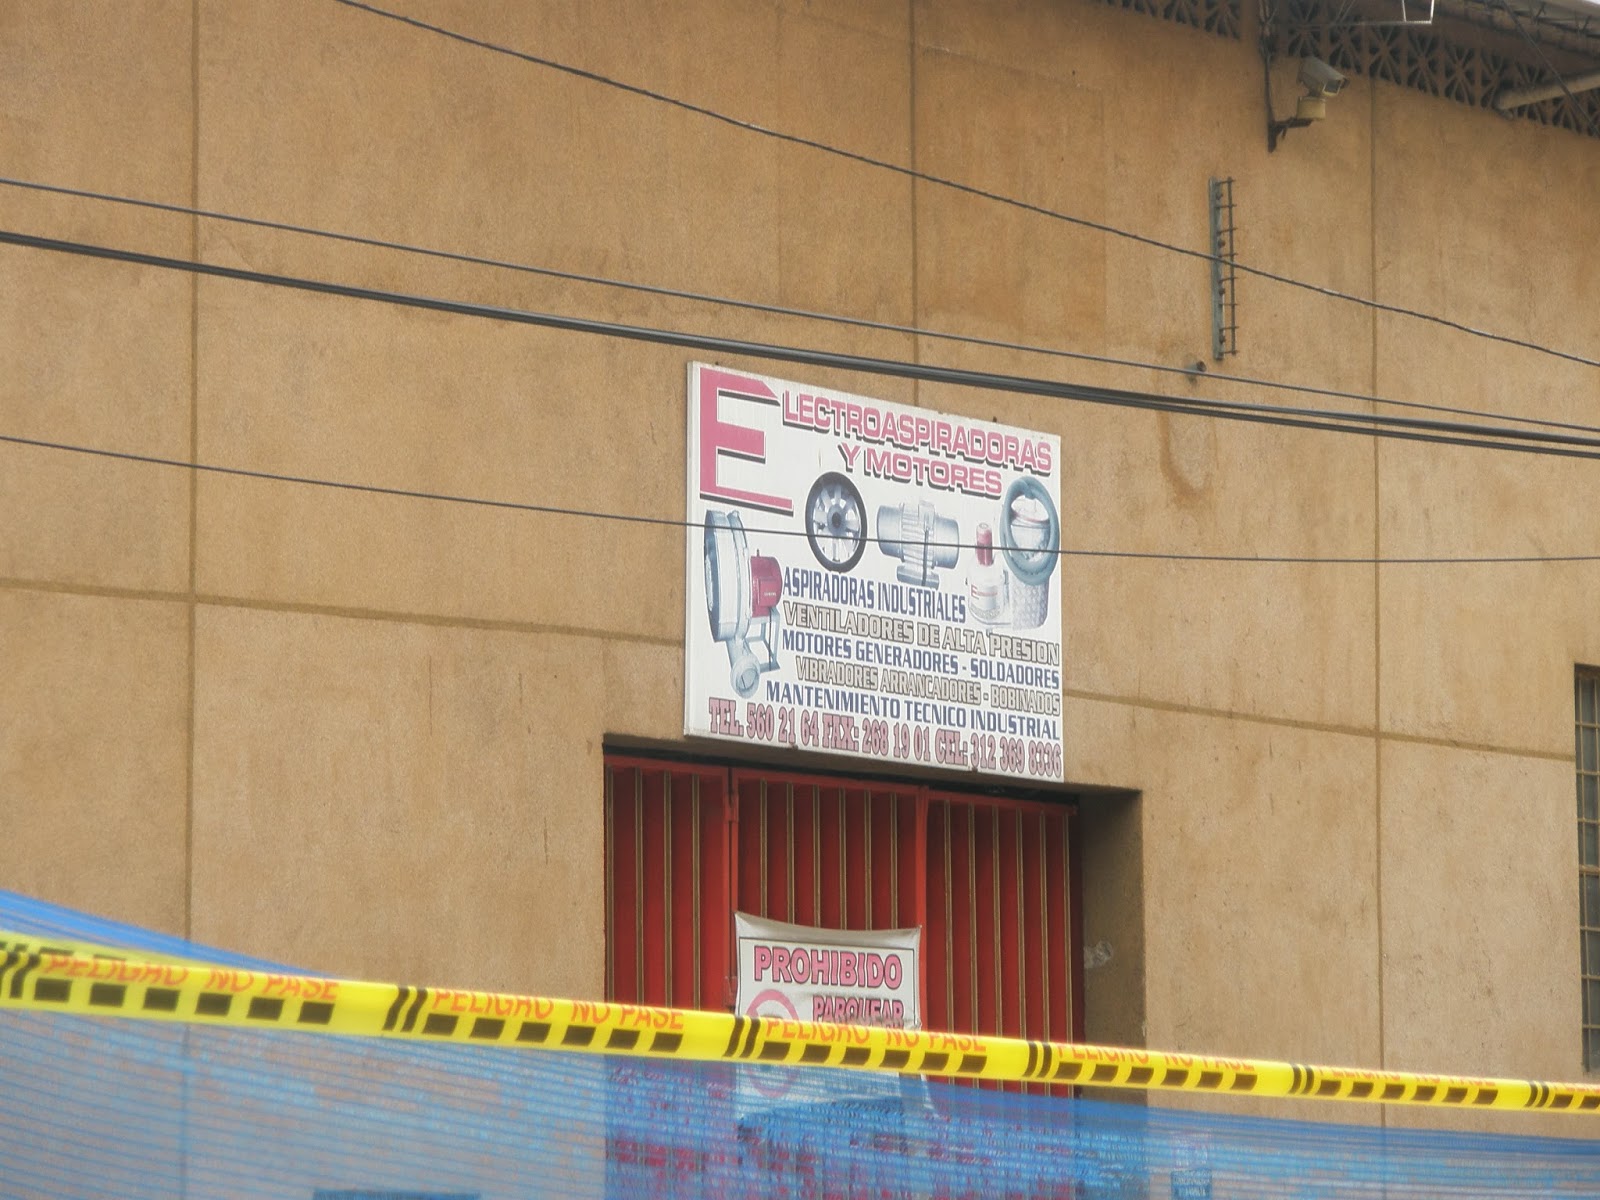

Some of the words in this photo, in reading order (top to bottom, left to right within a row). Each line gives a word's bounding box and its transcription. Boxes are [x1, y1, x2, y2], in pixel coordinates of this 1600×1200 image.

[837, 442, 861, 472] Y
[864, 447, 1003, 500] MOTORES
[783, 566, 875, 610] ASPIRADORAS
[878, 582, 966, 624] INDUSTRIALES
[782, 628, 851, 658] MOTORES
[855, 642, 959, 674] GENERADORES
[970, 658, 1060, 690] SOLDADORES
[783, 600, 914, 644] VENTILADORES
[917, 623, 940, 648] DE
[942, 626, 986, 654] ALTA
[988, 633, 1060, 666] PRESION
[766, 680, 900, 719] MANTENIMIENTO
[904, 700, 966, 727] TECNICO
[970, 709, 1060, 740] INDUSTRIAL
[796, 656, 878, 690] VIBRADORES
[880, 671, 981, 704] ARRANCADORES
[990, 685, 1060, 717] BOBINADOS
[709, 697, 743, 737] TEL.
[747, 702, 774, 742] 560
[778, 706, 796, 744] 21
[800, 709, 819, 748] 64
[822, 713, 859, 752] FAX:
[862, 718, 888, 756] 268
[893, 722, 910, 759] 19
[914, 725, 931, 762] 01
[934, 730, 968, 767] CEL:
[970, 732, 996, 770] 312
[1000, 738, 1026, 774] 369
[754, 945, 903, 990] PROHIBIDO
